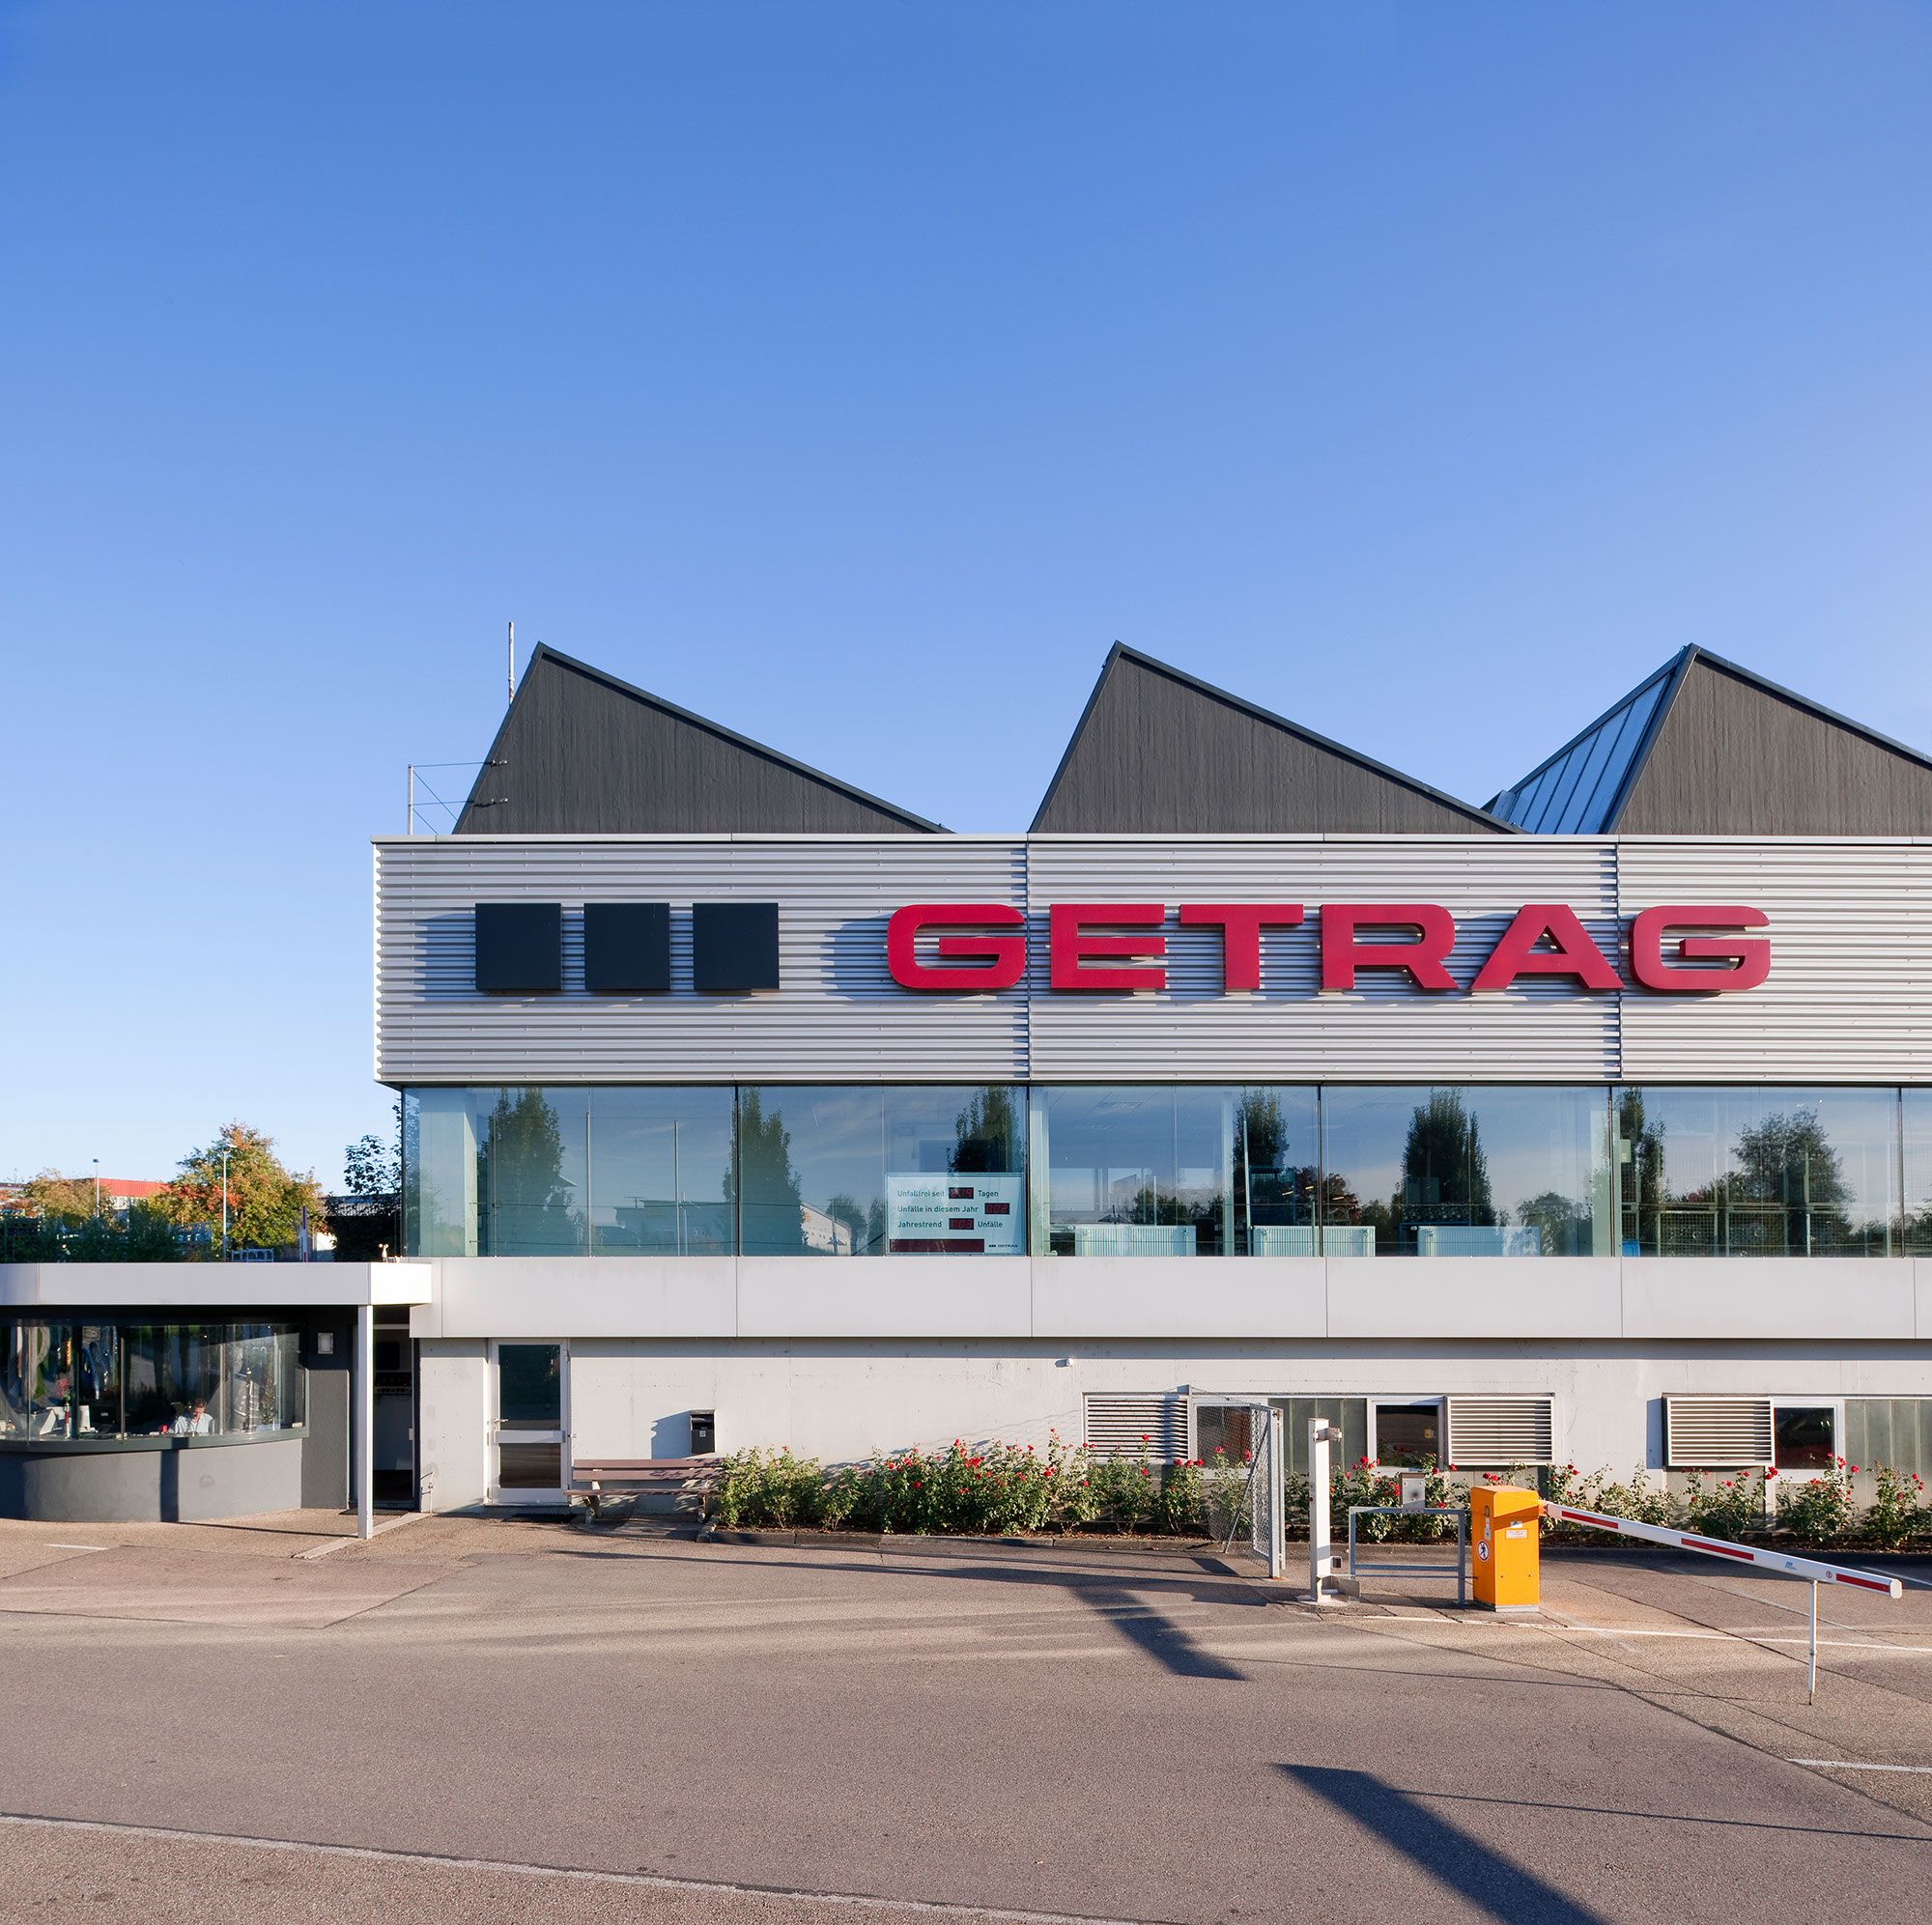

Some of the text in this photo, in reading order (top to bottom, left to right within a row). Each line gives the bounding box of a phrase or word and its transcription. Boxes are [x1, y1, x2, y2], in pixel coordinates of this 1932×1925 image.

[887, 904, 1770, 992] GETRAG
[896, 1189, 930, 1198] Unfallfrei
[978, 1189, 999, 1199] Tagen
[896, 1204, 923, 1213] Unfälle
[925, 1204, 933, 1213] in
[934, 1204, 961, 1213] diesem
[897, 1220, 943, 1229] Jahrestrend
[978, 1220, 1003, 1229] Unfälle
